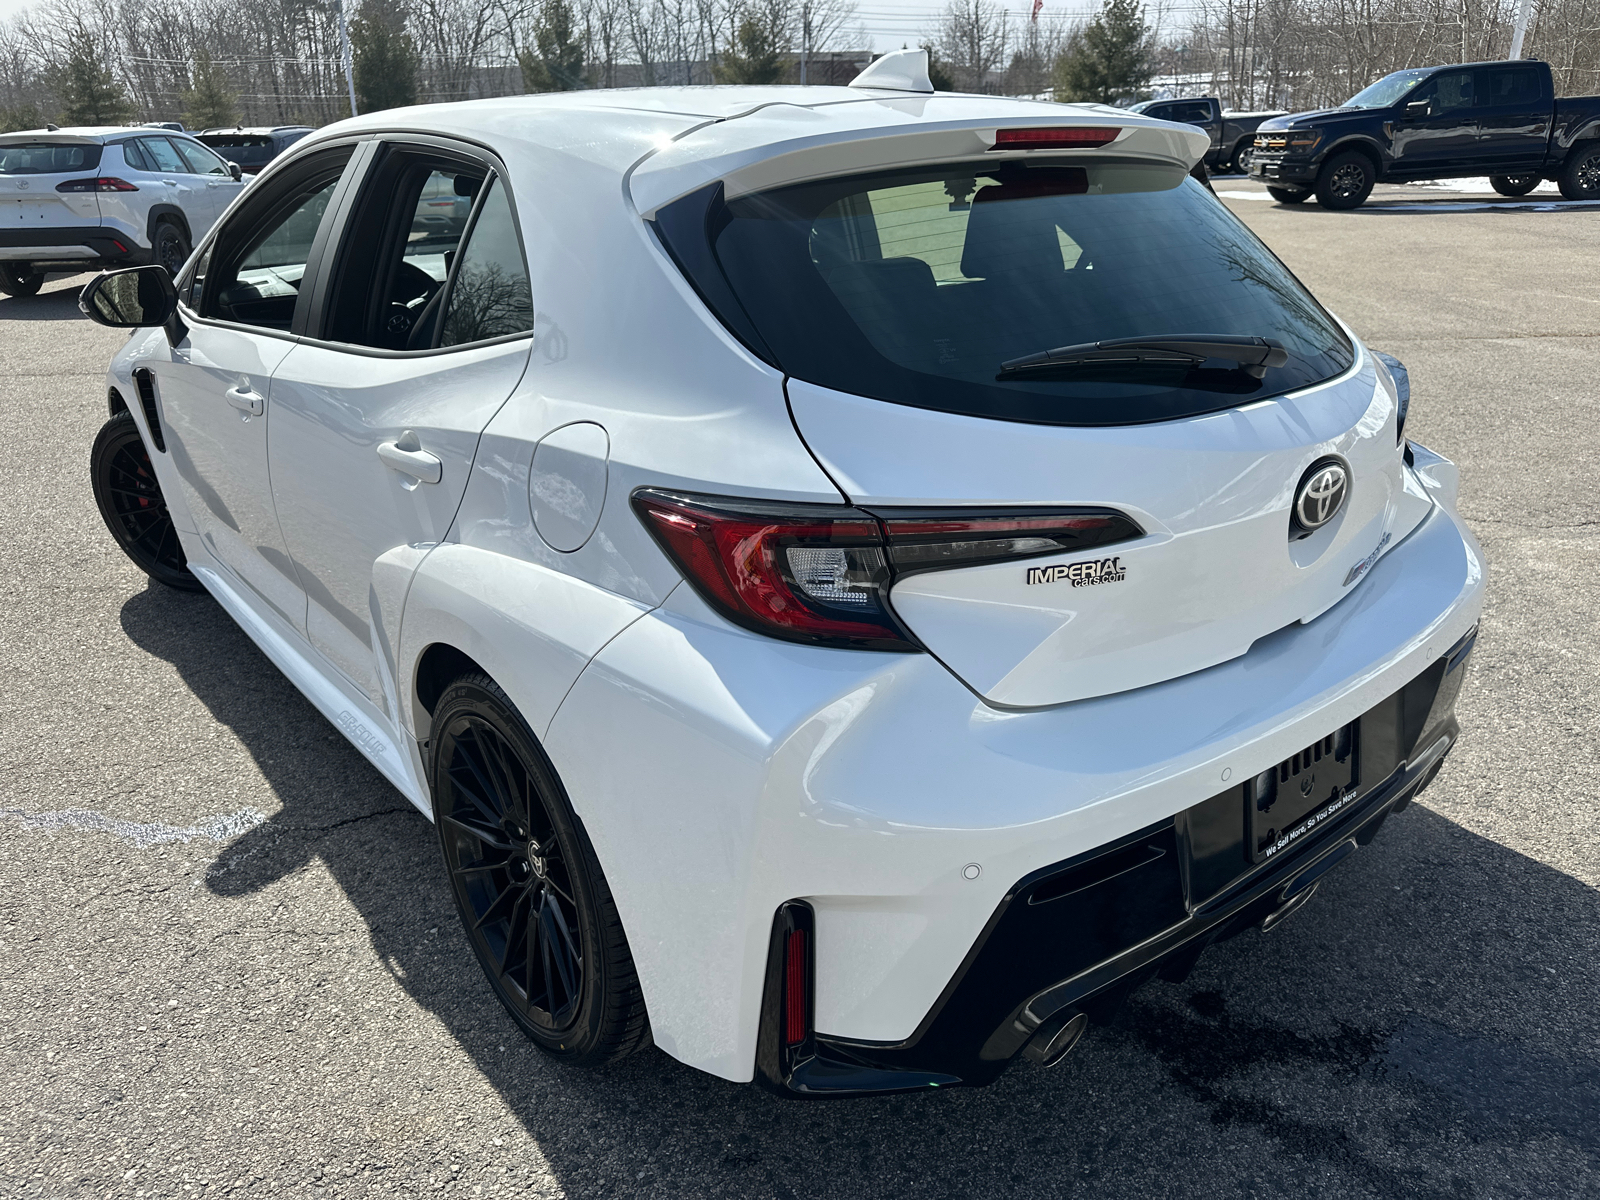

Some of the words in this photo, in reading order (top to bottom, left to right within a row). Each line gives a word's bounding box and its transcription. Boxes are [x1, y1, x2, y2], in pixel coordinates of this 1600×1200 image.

[1027, 557, 1126, 585] IMPERIAL
[1072, 572, 1125, 588] cars.com
[1265, 845, 1277, 857] We
[1277, 836, 1289, 850] Sell
[1289, 826, 1307, 841] More,
[1307, 819, 1316, 829] So
[1316, 810, 1328, 822] You
[1328, 800, 1342, 814] Save
[1342, 790, 1357, 805] More
